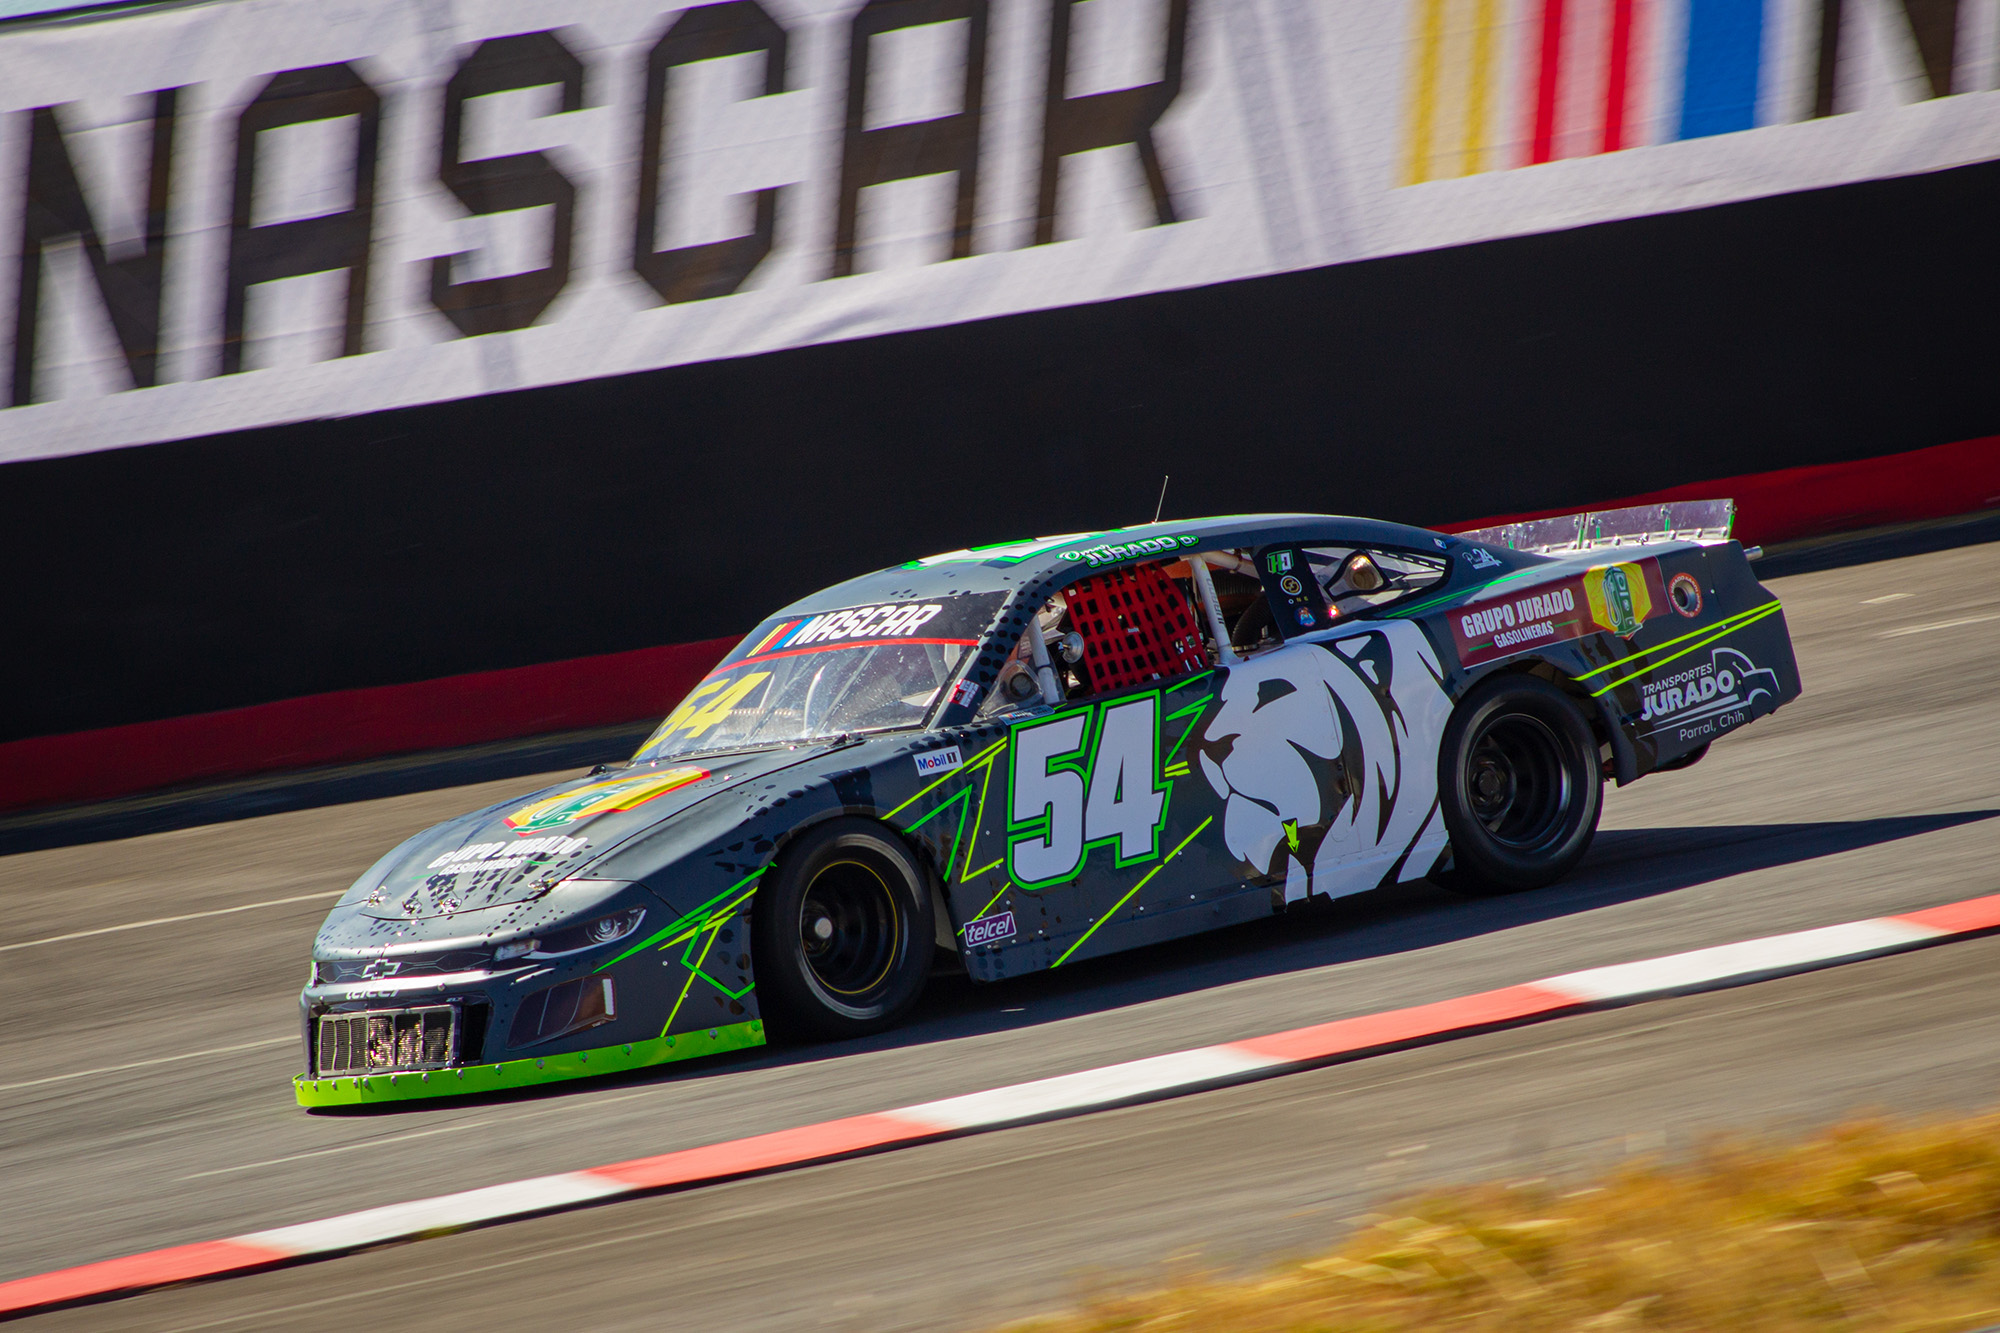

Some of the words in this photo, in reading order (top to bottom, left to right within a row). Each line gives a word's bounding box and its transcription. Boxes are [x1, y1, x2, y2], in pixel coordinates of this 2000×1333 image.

[5, 0, 1207, 406] NASCAR
[1088, 536, 1178, 567] JURADO
[783, 604, 943, 647] NASCAR
[1461, 603, 1516, 638] GRUPO
[1515, 588, 1575, 624] JURADO
[1493, 620, 1555, 648] GASOLINERAS
[1640, 670, 1735, 721] JURADO
[1642, 663, 1713, 696] TRANSPORTES
[1679, 720, 1717, 741] Parral,
[1719, 710, 1745, 728] Chih
[918, 754, 947, 770] Mobil
[1013, 698, 1164, 884] 54
[968, 915, 1010, 943] telcel
